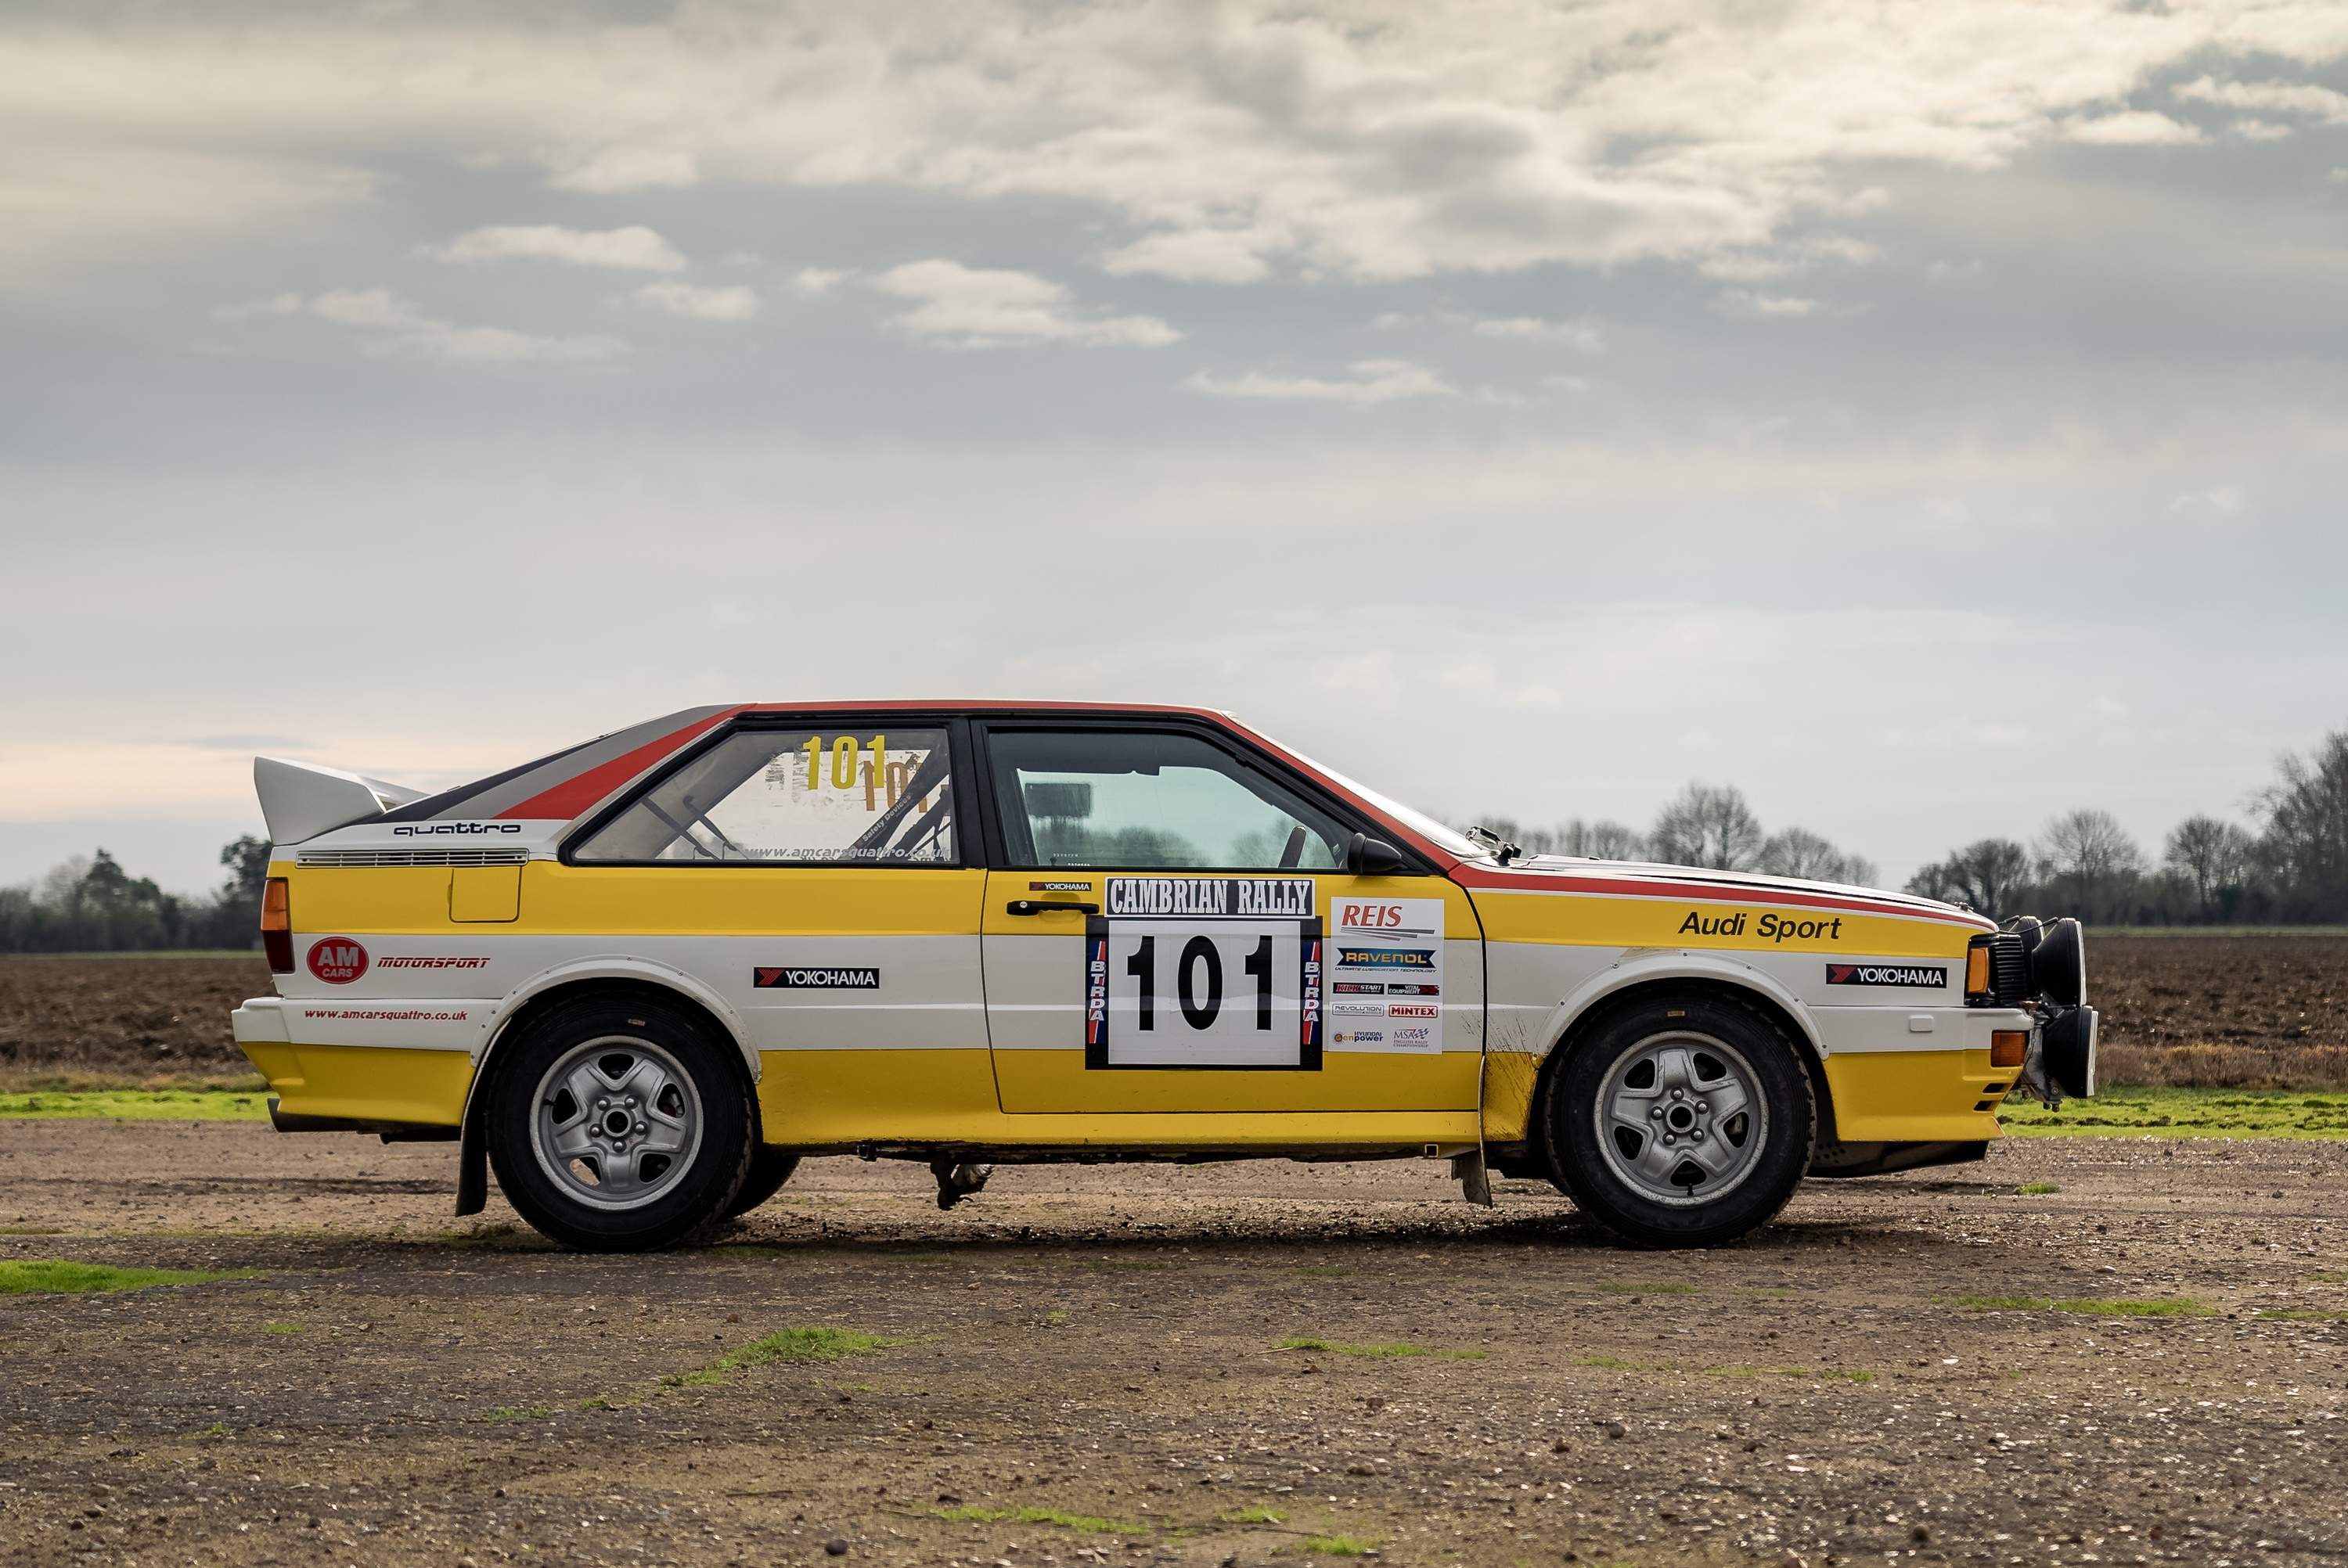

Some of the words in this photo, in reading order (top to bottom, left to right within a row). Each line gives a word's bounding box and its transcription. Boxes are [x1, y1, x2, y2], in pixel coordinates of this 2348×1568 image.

[803, 735, 885, 790] 101
[394, 822, 521, 836] quattro
[862, 819, 885, 843] Safety
[744, 847, 951, 859] www.amcarsquattro.co.uk
[1111, 879, 1228, 914] CAMBRIAN
[1237, 880, 1310, 915] RALLY
[1341, 904, 1403, 927] REIS
[1677, 912, 1748, 936] Audi
[1756, 913, 1842, 943] Sport
[317, 946, 358, 967] AM
[377, 957, 492, 969] MOTORSPORT
[1346, 952, 1427, 964] RAVENOL
[322, 968, 353, 978] CARS
[785, 970, 876, 985] YOKOHAMA
[1856, 968, 1943, 985] YOKOHAMA
[1089, 961, 1106, 1021] BTRDA
[1127, 935, 1273, 1031] 101
[1335, 984, 1360, 993] KICK
[1303, 962, 1320, 1022] BTRDA
[304, 1010, 468, 1021] www.amcarsquattro.co.uk
[1392, 1007, 1435, 1016] MINTEX
[1393, 1030, 1415, 1039] MSA
